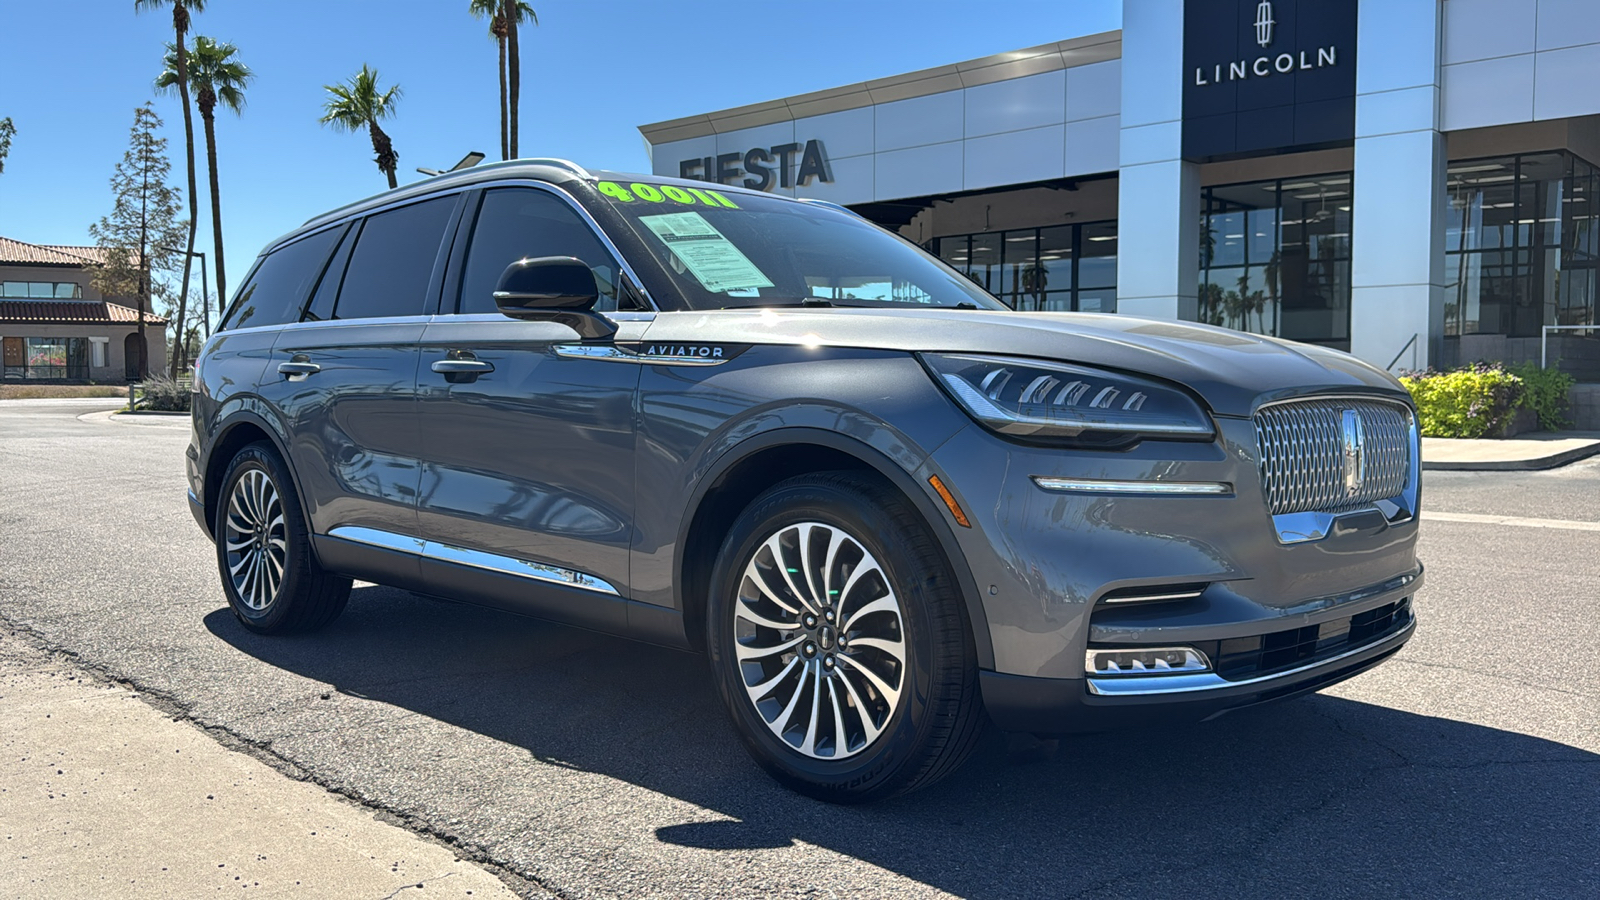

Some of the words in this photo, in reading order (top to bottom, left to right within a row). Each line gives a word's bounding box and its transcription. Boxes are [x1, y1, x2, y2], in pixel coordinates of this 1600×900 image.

[1196, 46, 1335, 85] LINCOLN
[680, 139, 833, 192] FIESTA
[598, 181, 740, 209] 40011
[648, 346, 723, 357] AVIATOR
